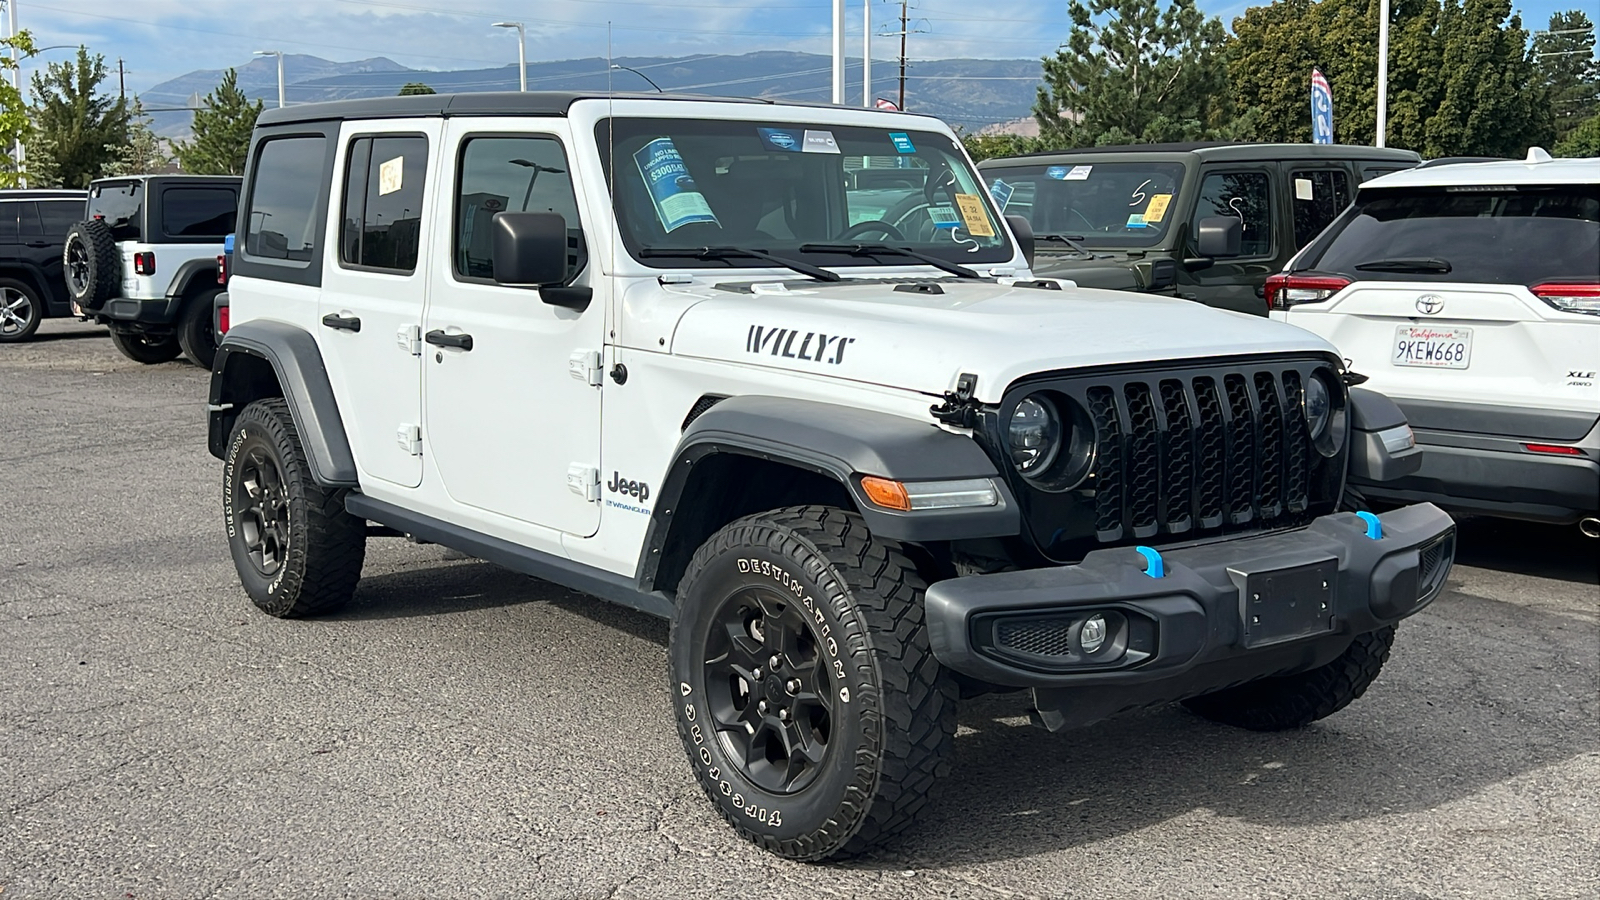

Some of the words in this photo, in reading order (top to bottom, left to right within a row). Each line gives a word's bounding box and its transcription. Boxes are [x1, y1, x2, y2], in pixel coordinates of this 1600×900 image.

[650, 164, 672, 181] $300
[746, 324, 856, 365] WILLYS
[1410, 328, 1455, 341] California
[1396, 340, 1465, 362] 9KEW668
[1566, 370, 1597, 379] XLE
[225, 434, 244, 538] DESTINATION
[607, 470, 650, 504] Jeep
[612, 500, 651, 515] WRANGLER
[737, 557, 846, 680] DESTINATION
